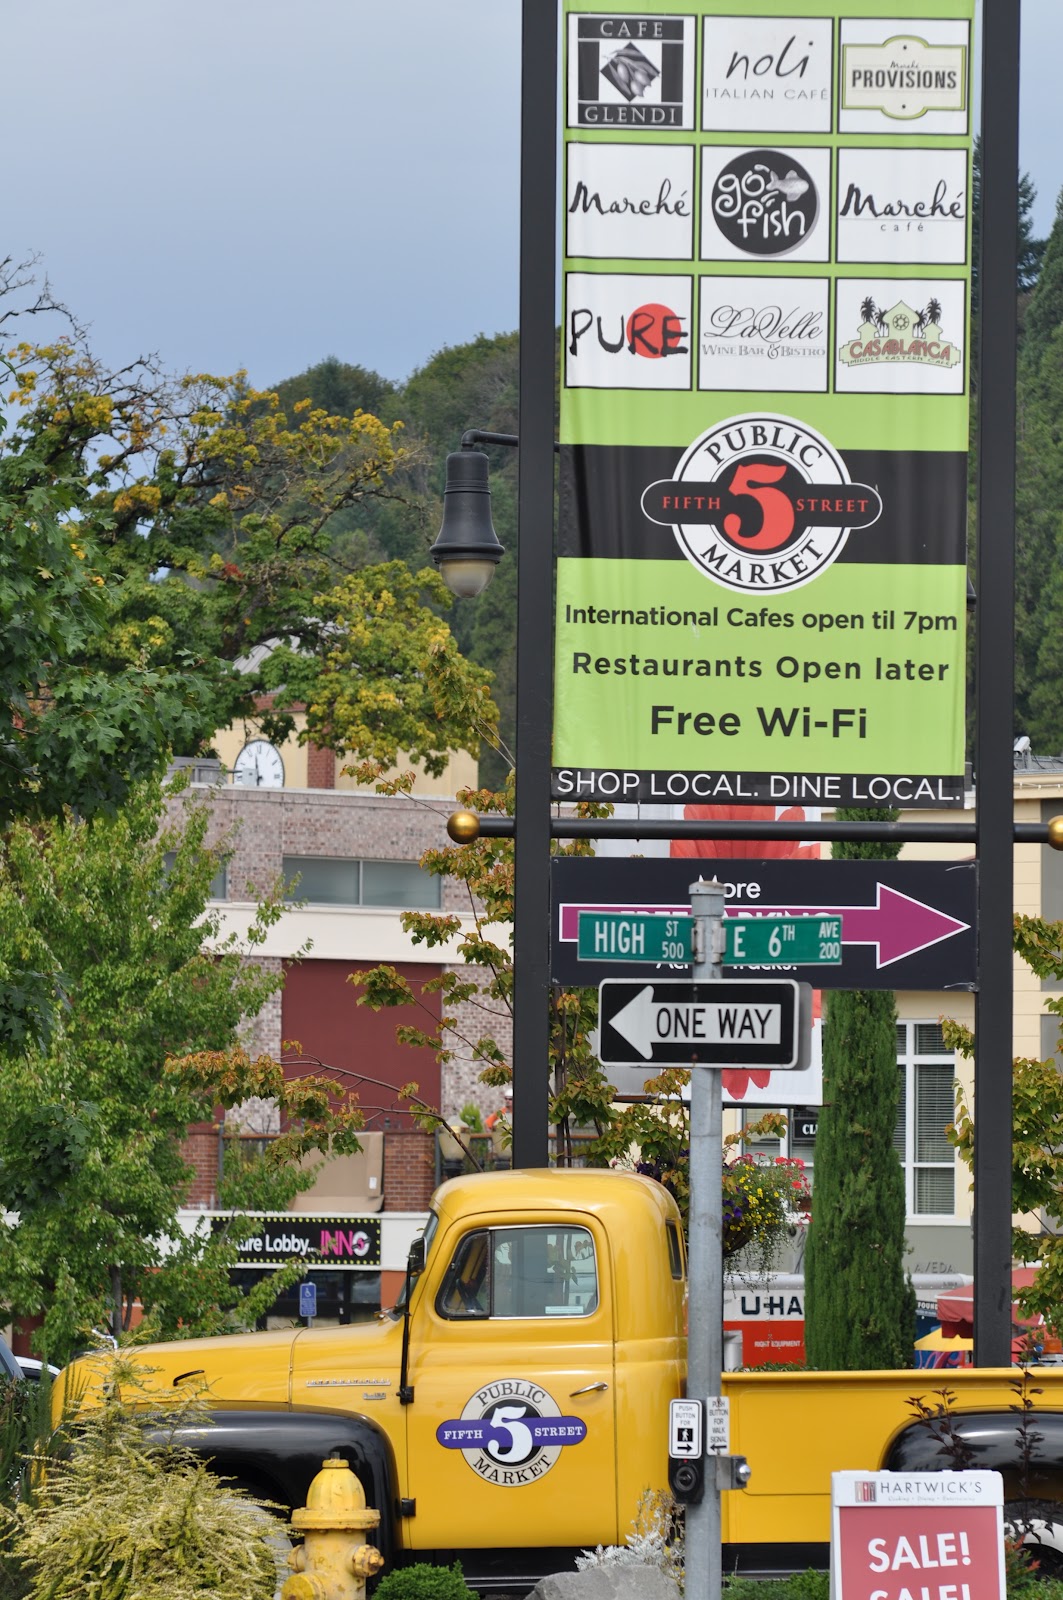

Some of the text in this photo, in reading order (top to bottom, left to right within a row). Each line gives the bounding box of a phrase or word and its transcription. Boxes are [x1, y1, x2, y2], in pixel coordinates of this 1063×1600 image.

[600, 21, 664, 38] CAFE
[725, 35, 814, 80] noli
[706, 87, 829, 100] ITALIAN CAFÉ
[851, 69, 957, 89] PROVISIONS
[584, 106, 676, 124] GLENDI
[568, 178, 691, 217] Marché
[714, 170, 766, 217] go
[839, 179, 965, 219] Marché
[737, 200, 805, 238] fish
[880, 222, 924, 232] café
[569, 308, 689, 357] PURE
[703, 304, 823, 343] LaVelle
[766, 343, 780, 360] &
[849, 338, 951, 361] CASABLANCA
[704, 425, 823, 468] PUBLIC
[662, 463, 869, 550] FIFTH 5 STREET
[700, 538, 823, 584] MARKET
[566, 604, 958, 634] International Cafes open til 7pm
[572, 652, 949, 683] Restaurants Open later
[651, 705, 867, 739] Free Wi-Fi
[557, 770, 961, 801] SHOP LOCAL. DINE LOCAL.
[594, 920, 679, 954] HIGH ST
[662, 941, 684, 959] 500
[733, 922, 839, 958] E 6TH AVE
[819, 942, 839, 960] 200
[656, 1007, 773, 1039] ONE WAY
[475, 1380, 546, 1407] PUBLIC
[709, 1409, 729, 1417] BUTTON
[443, 1406, 583, 1463] FIFTH 5 STREET
[472, 1454, 553, 1485] MARKET
[880, 1481, 982, 1493] HARTWICK'S
[868, 1531, 972, 1573] SALE!
